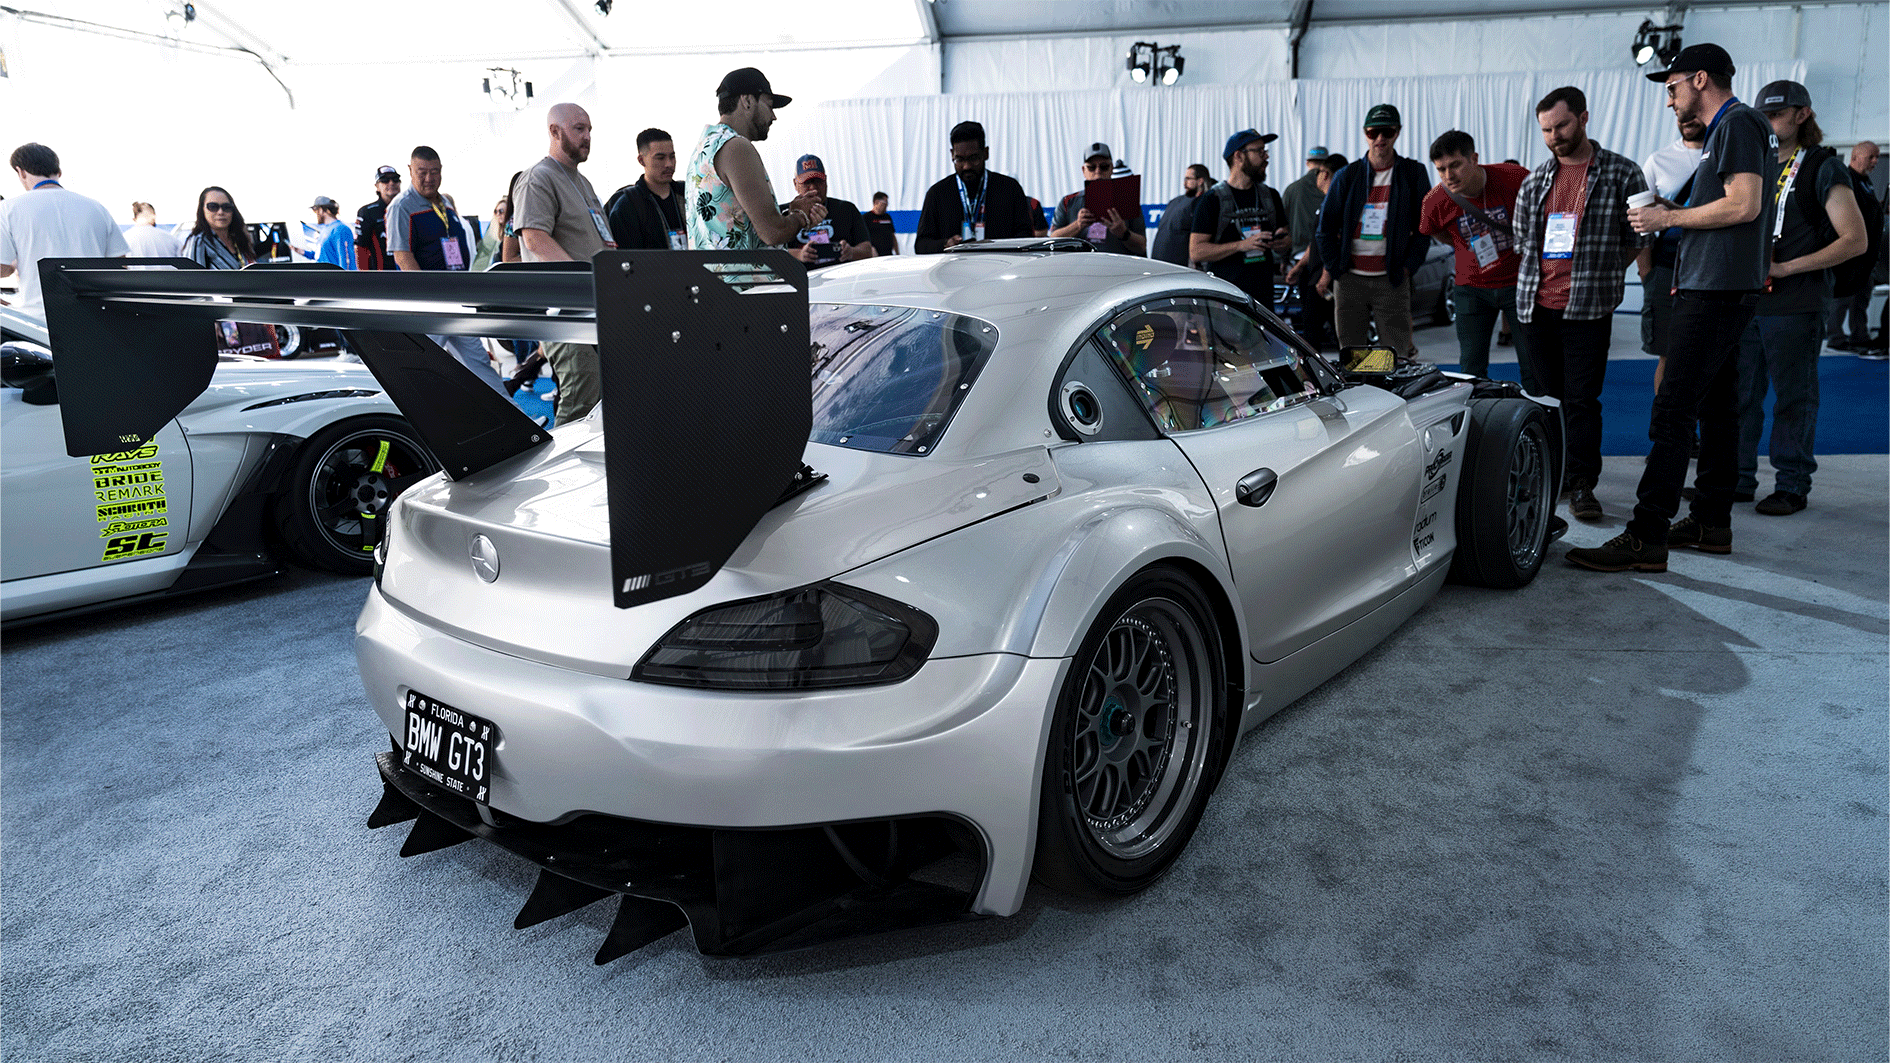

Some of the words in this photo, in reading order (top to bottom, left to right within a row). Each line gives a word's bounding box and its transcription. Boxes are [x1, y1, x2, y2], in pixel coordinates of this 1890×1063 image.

[93, 470, 164, 488] BRIDE
[94, 483, 165, 502] REMARK
[654, 561, 711, 586] GT3
[431, 703, 464, 728] FLORIDA
[407, 711, 443, 762] BMW
[448, 731, 485, 781] GT3
[419, 763, 444, 784] SUNSHINE
[446, 776, 464, 792] STATE
